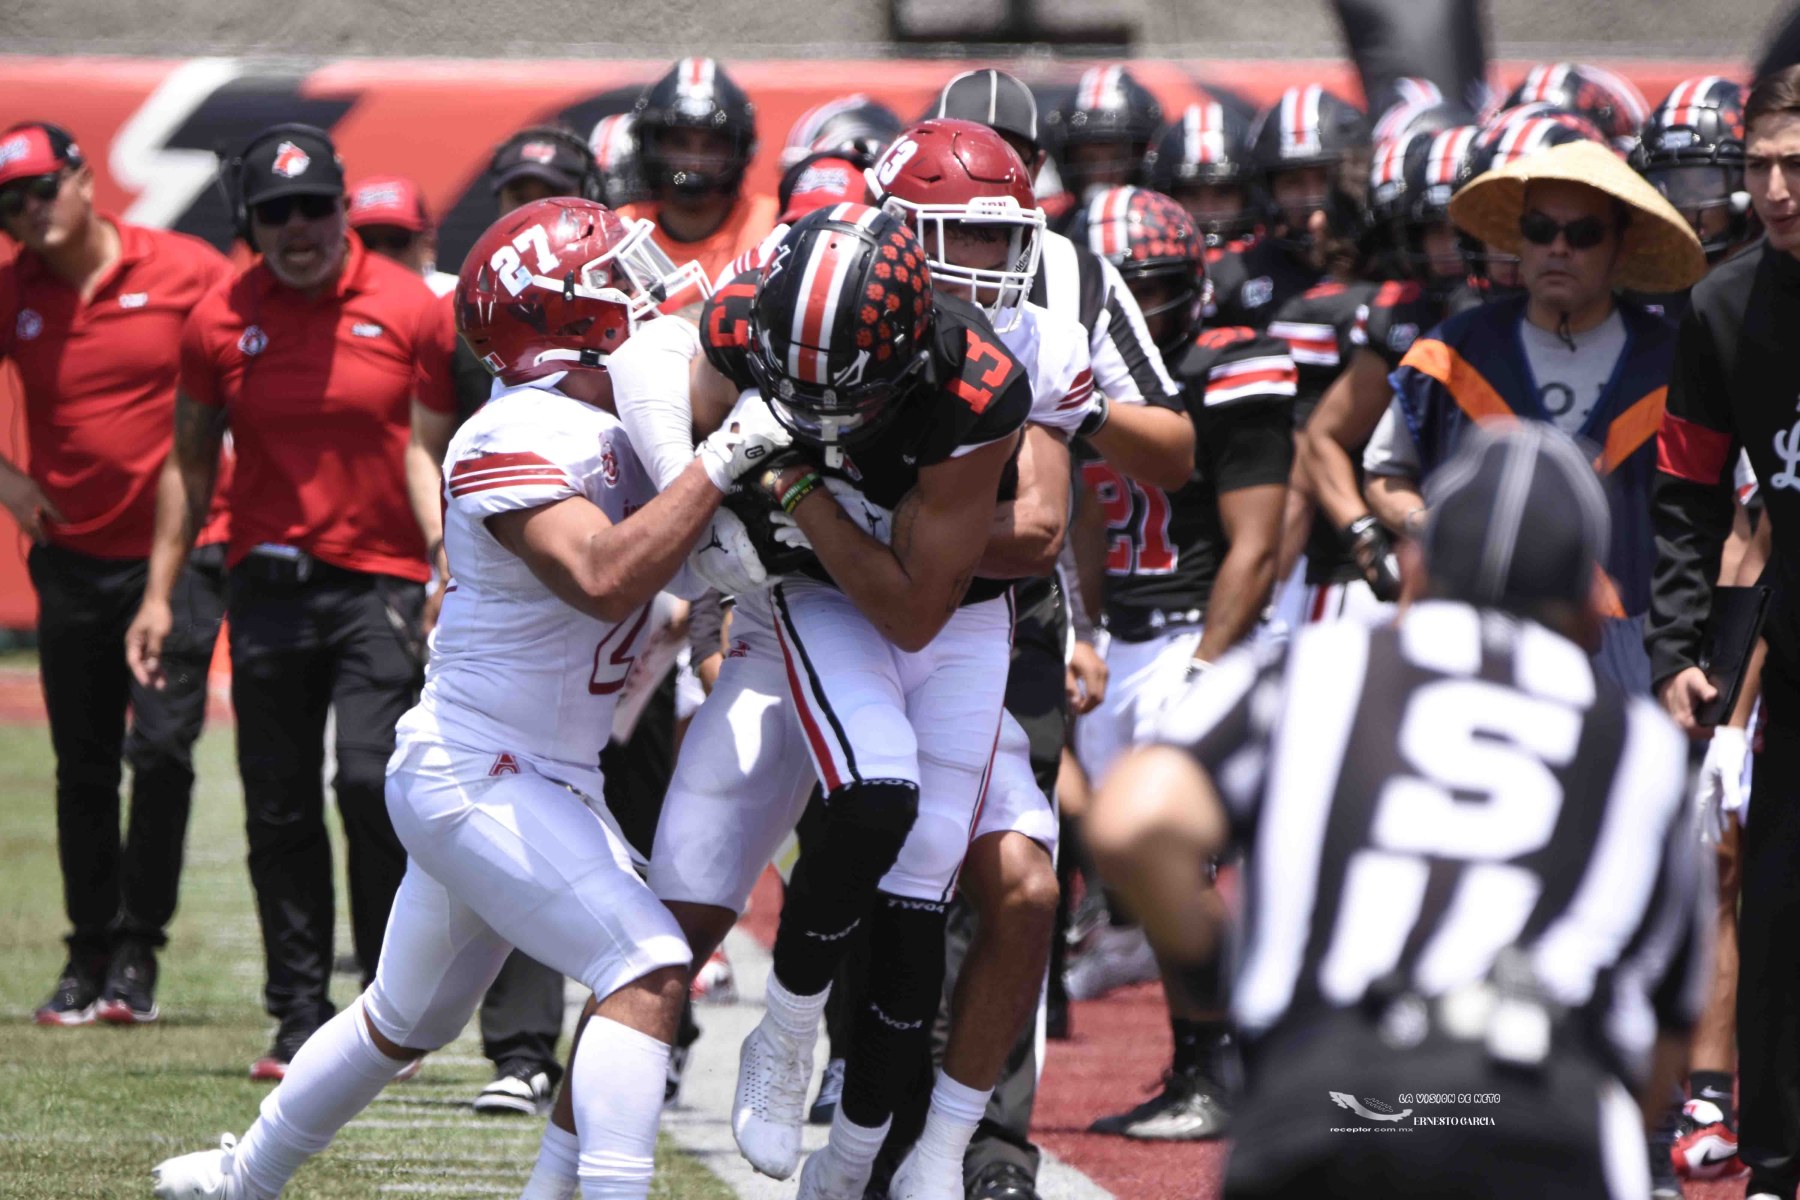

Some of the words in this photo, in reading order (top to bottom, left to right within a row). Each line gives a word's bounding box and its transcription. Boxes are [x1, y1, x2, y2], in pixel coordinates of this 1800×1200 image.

[490, 223, 560, 297] 27
[946, 328, 1014, 415] 13
[1369, 677, 1584, 862] S
